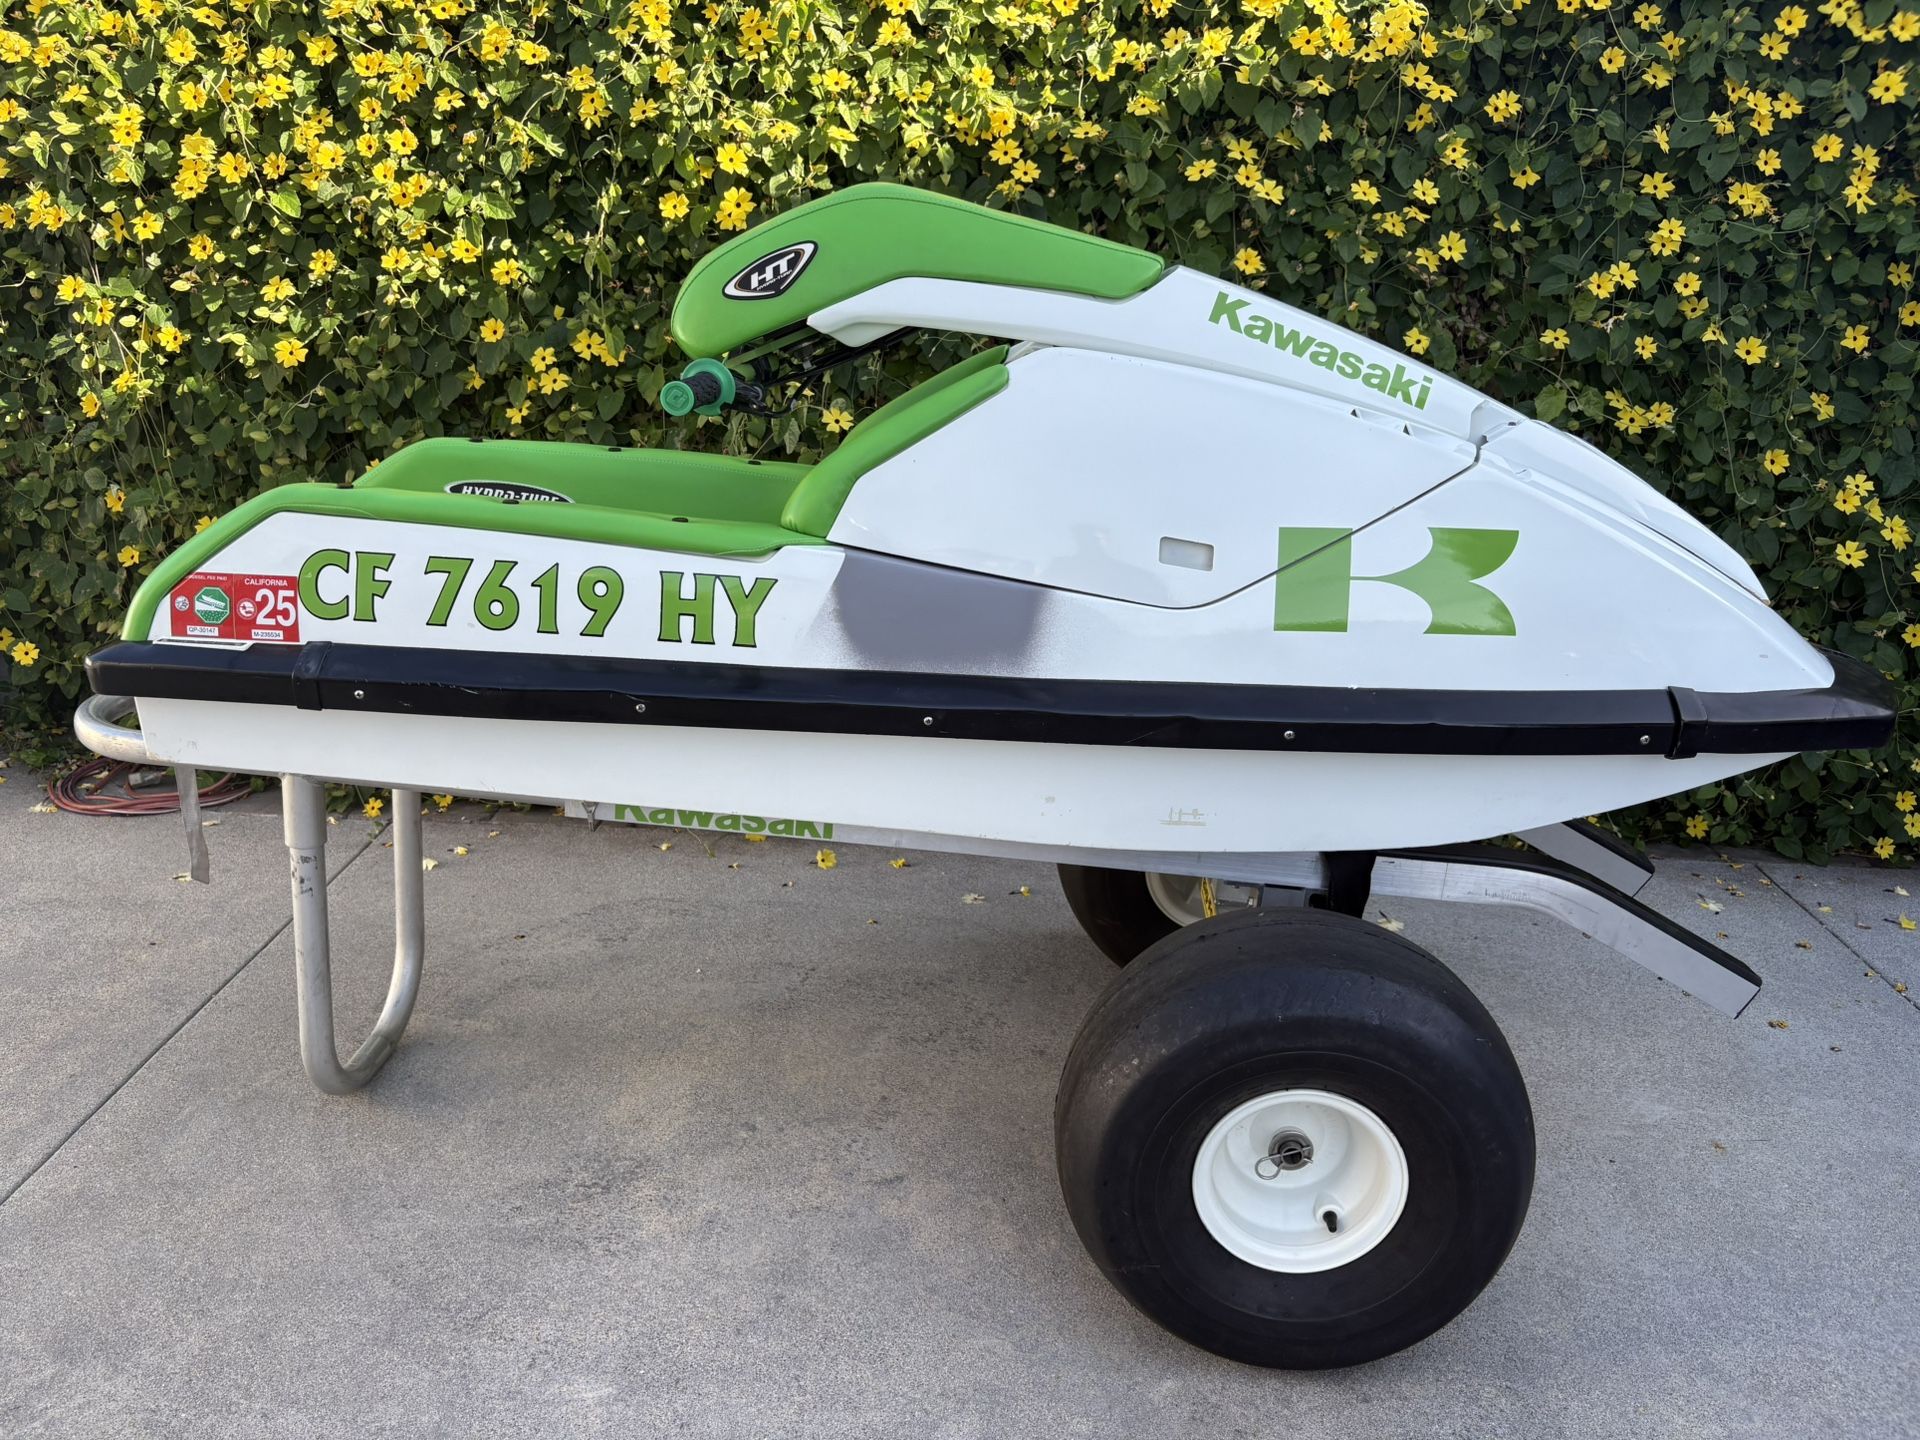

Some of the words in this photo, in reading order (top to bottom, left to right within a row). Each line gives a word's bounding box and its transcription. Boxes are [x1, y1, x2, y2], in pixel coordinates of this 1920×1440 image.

[750, 252, 795, 290] HT
[1208, 290, 1434, 411] Kawasaki
[244, 578, 288, 587] CALIFORNIA
[255, 588, 297, 627] 25
[298, 548, 396, 622] CF
[424, 556, 625, 638] 7619
[657, 570, 778, 648] HY
[1273, 526, 1520, 637] K
